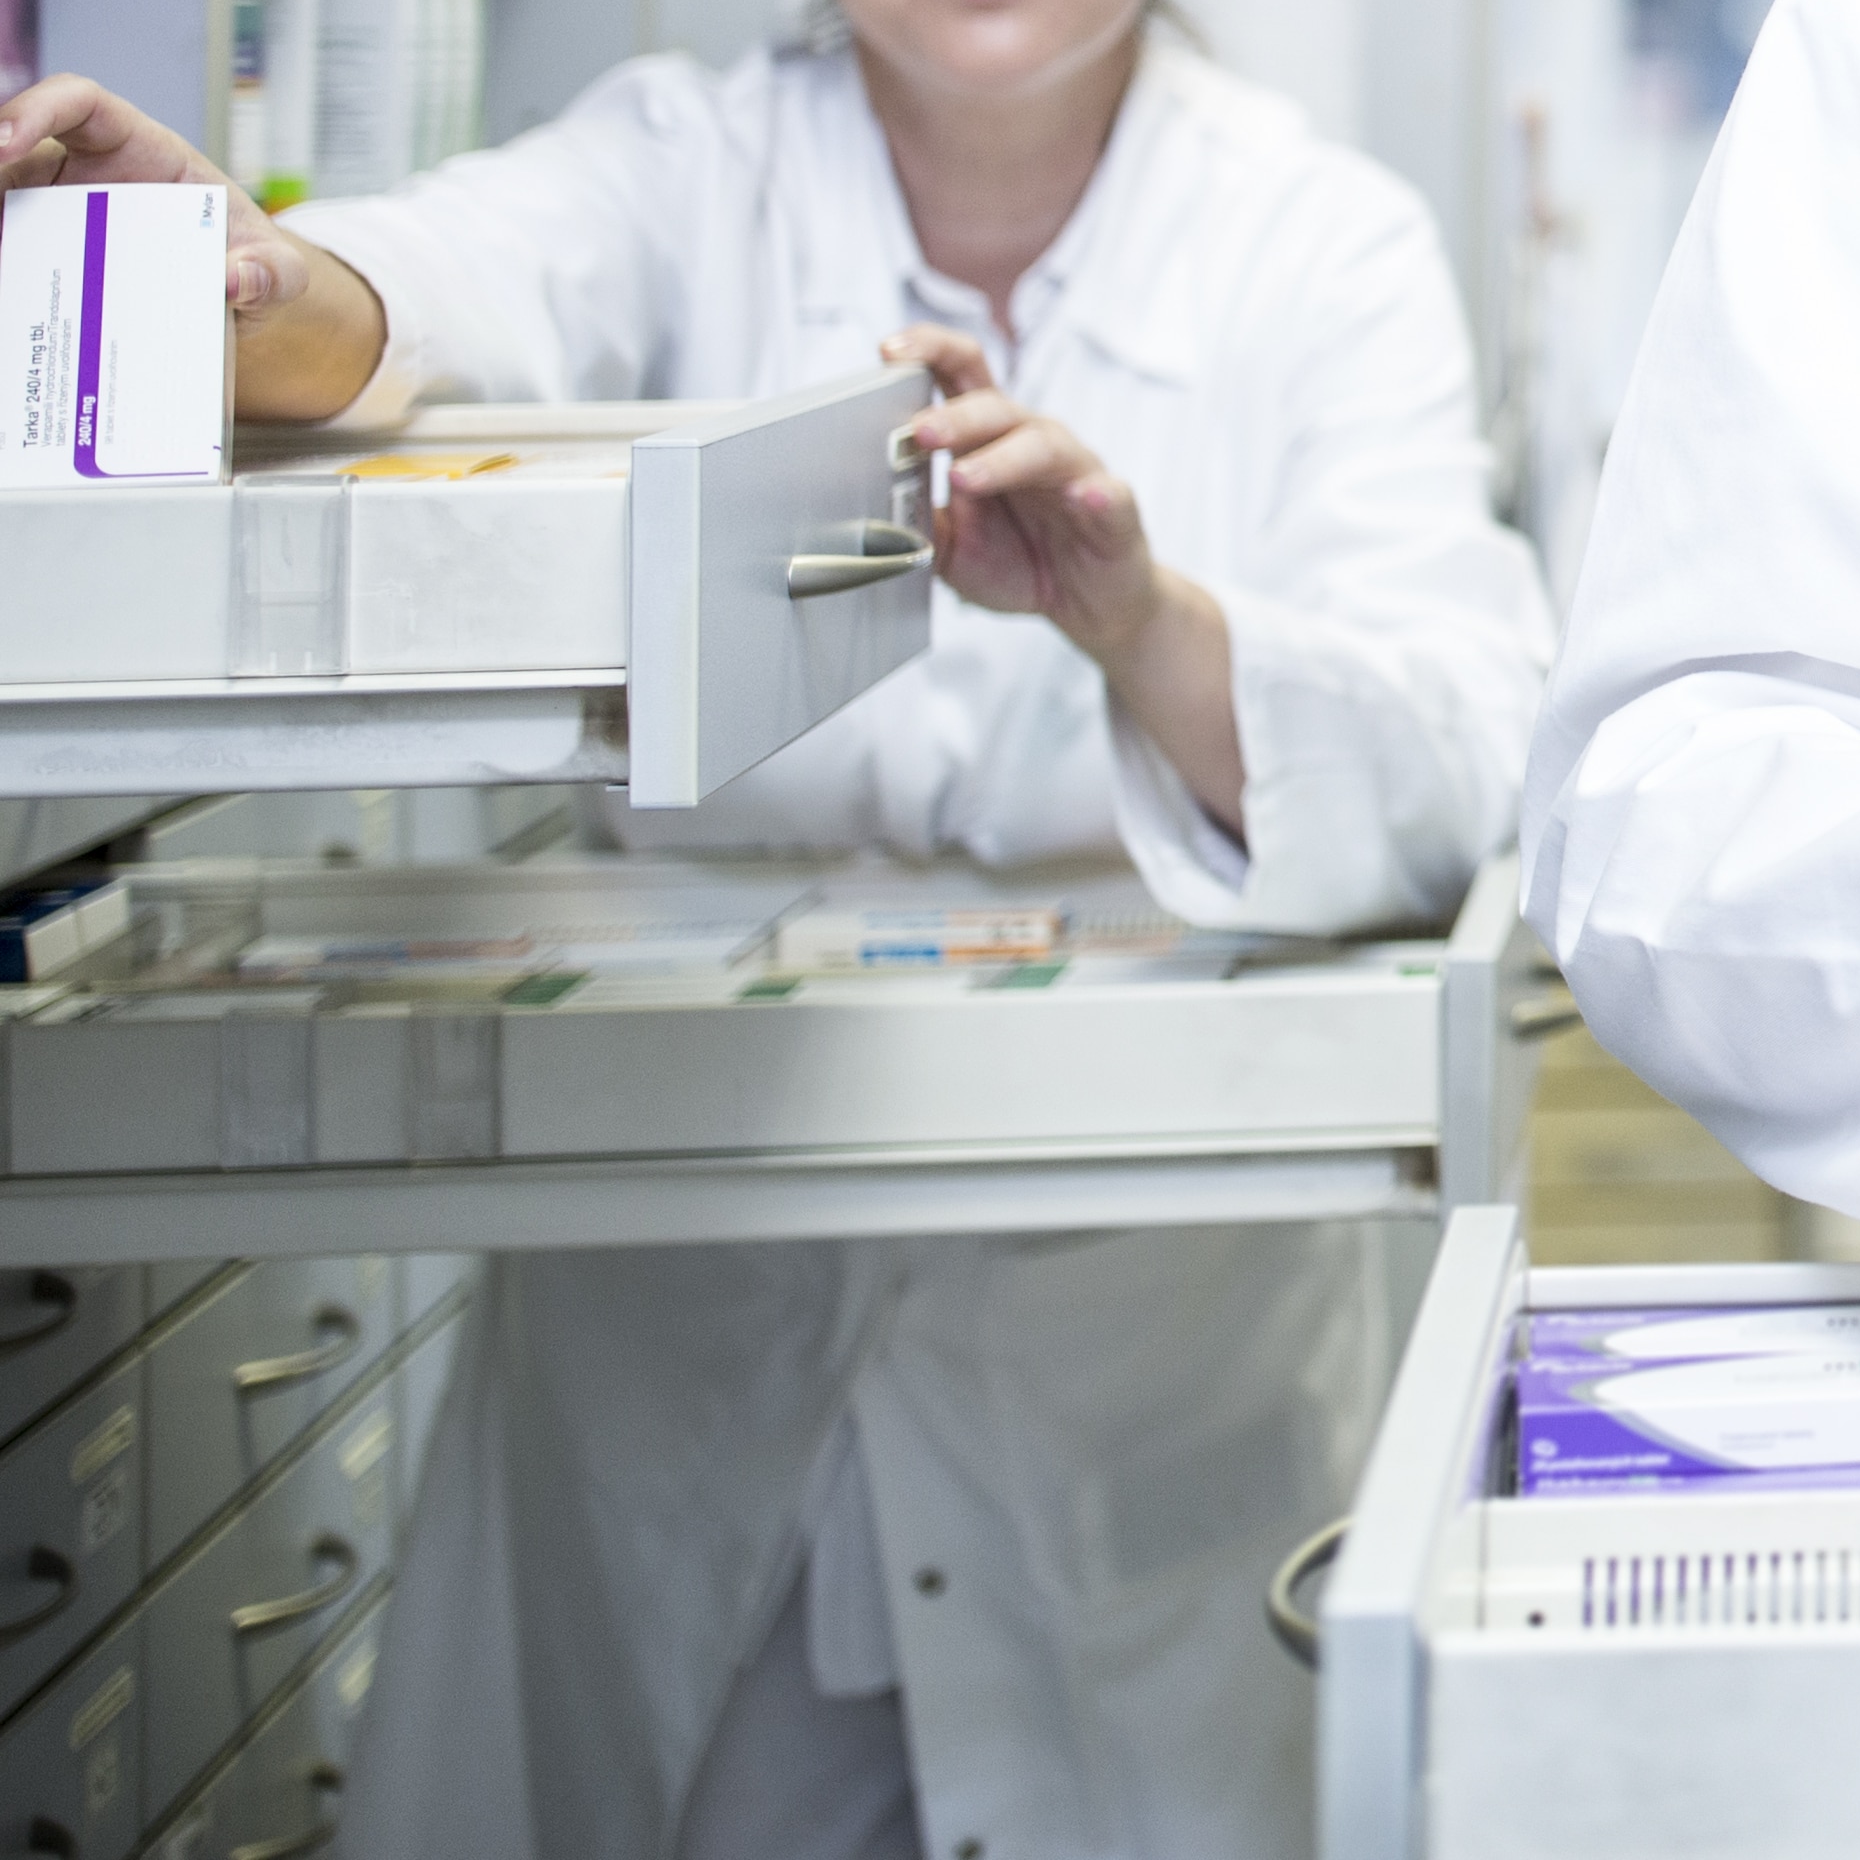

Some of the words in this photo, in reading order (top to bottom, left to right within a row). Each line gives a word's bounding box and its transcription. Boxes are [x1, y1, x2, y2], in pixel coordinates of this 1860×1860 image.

[30, 321, 45, 341] tbl.
[32, 345, 47, 364] mg
[26, 368, 41, 403] 240/4
[82, 395, 96, 414] mg
[78, 415, 92, 446] 240/4
